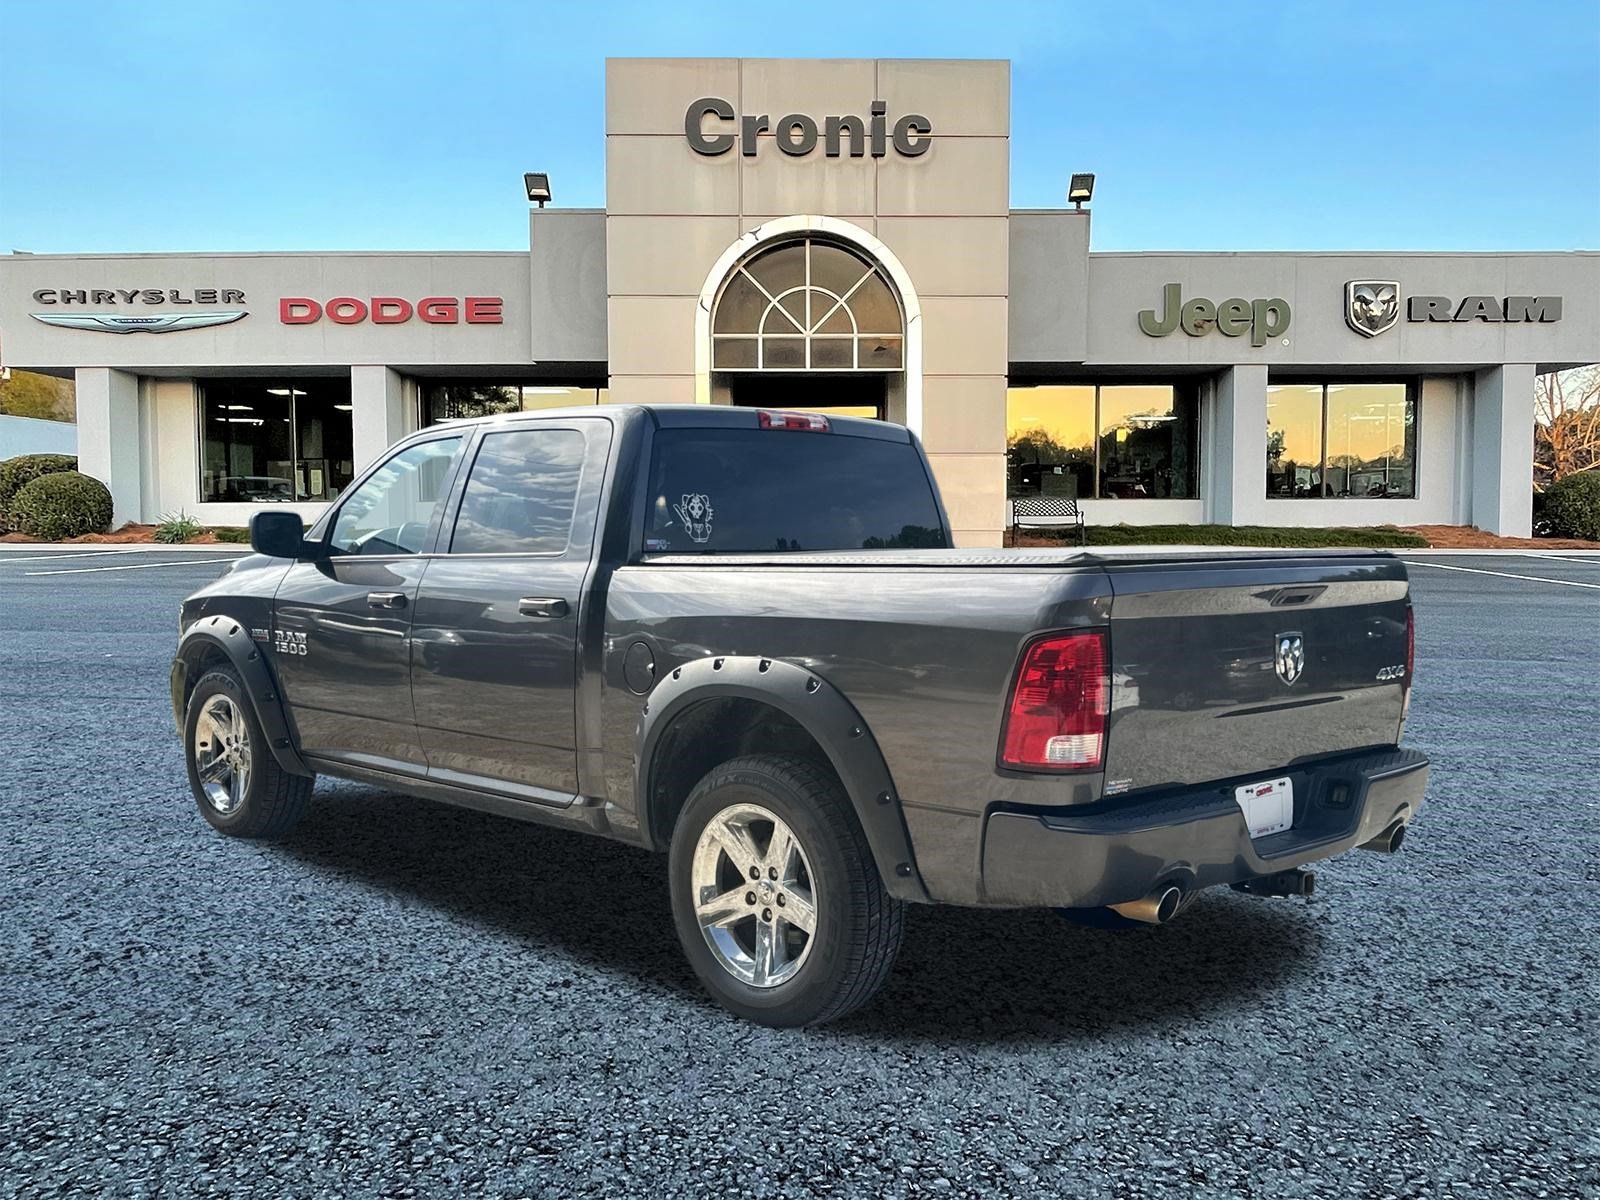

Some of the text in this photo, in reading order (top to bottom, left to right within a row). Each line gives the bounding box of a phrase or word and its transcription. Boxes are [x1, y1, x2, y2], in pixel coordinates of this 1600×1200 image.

[685, 97, 932, 157] Cronic
[32, 288, 247, 305] CHRYSLER
[1407, 296, 1563, 323] RAM
[279, 296, 504, 325] DODGE
[1138, 283, 1291, 347] Jeep
[274, 630, 307, 644] RAM
[274, 641, 308, 655] 1500
